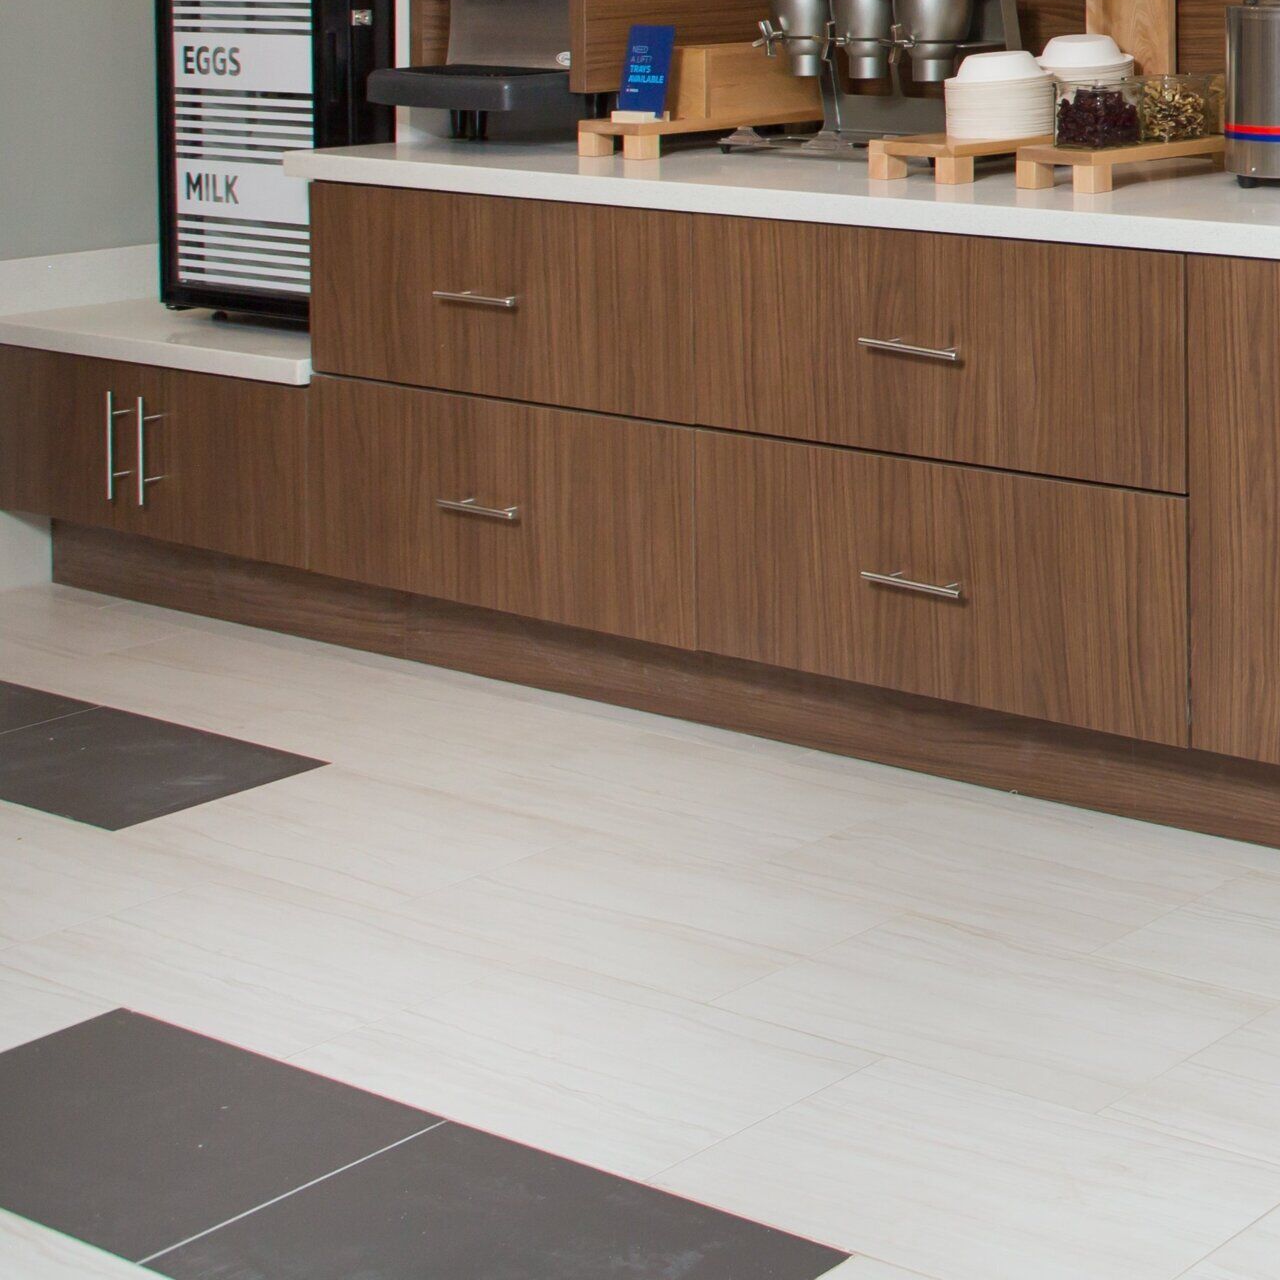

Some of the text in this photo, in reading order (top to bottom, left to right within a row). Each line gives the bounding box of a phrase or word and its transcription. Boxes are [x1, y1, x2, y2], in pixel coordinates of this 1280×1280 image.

[183, 45, 242, 77] EGGS
[629, 65, 651, 73] TRAYS
[628, 74, 664, 84] AVAILABLE
[185, 171, 240, 205] MILK
